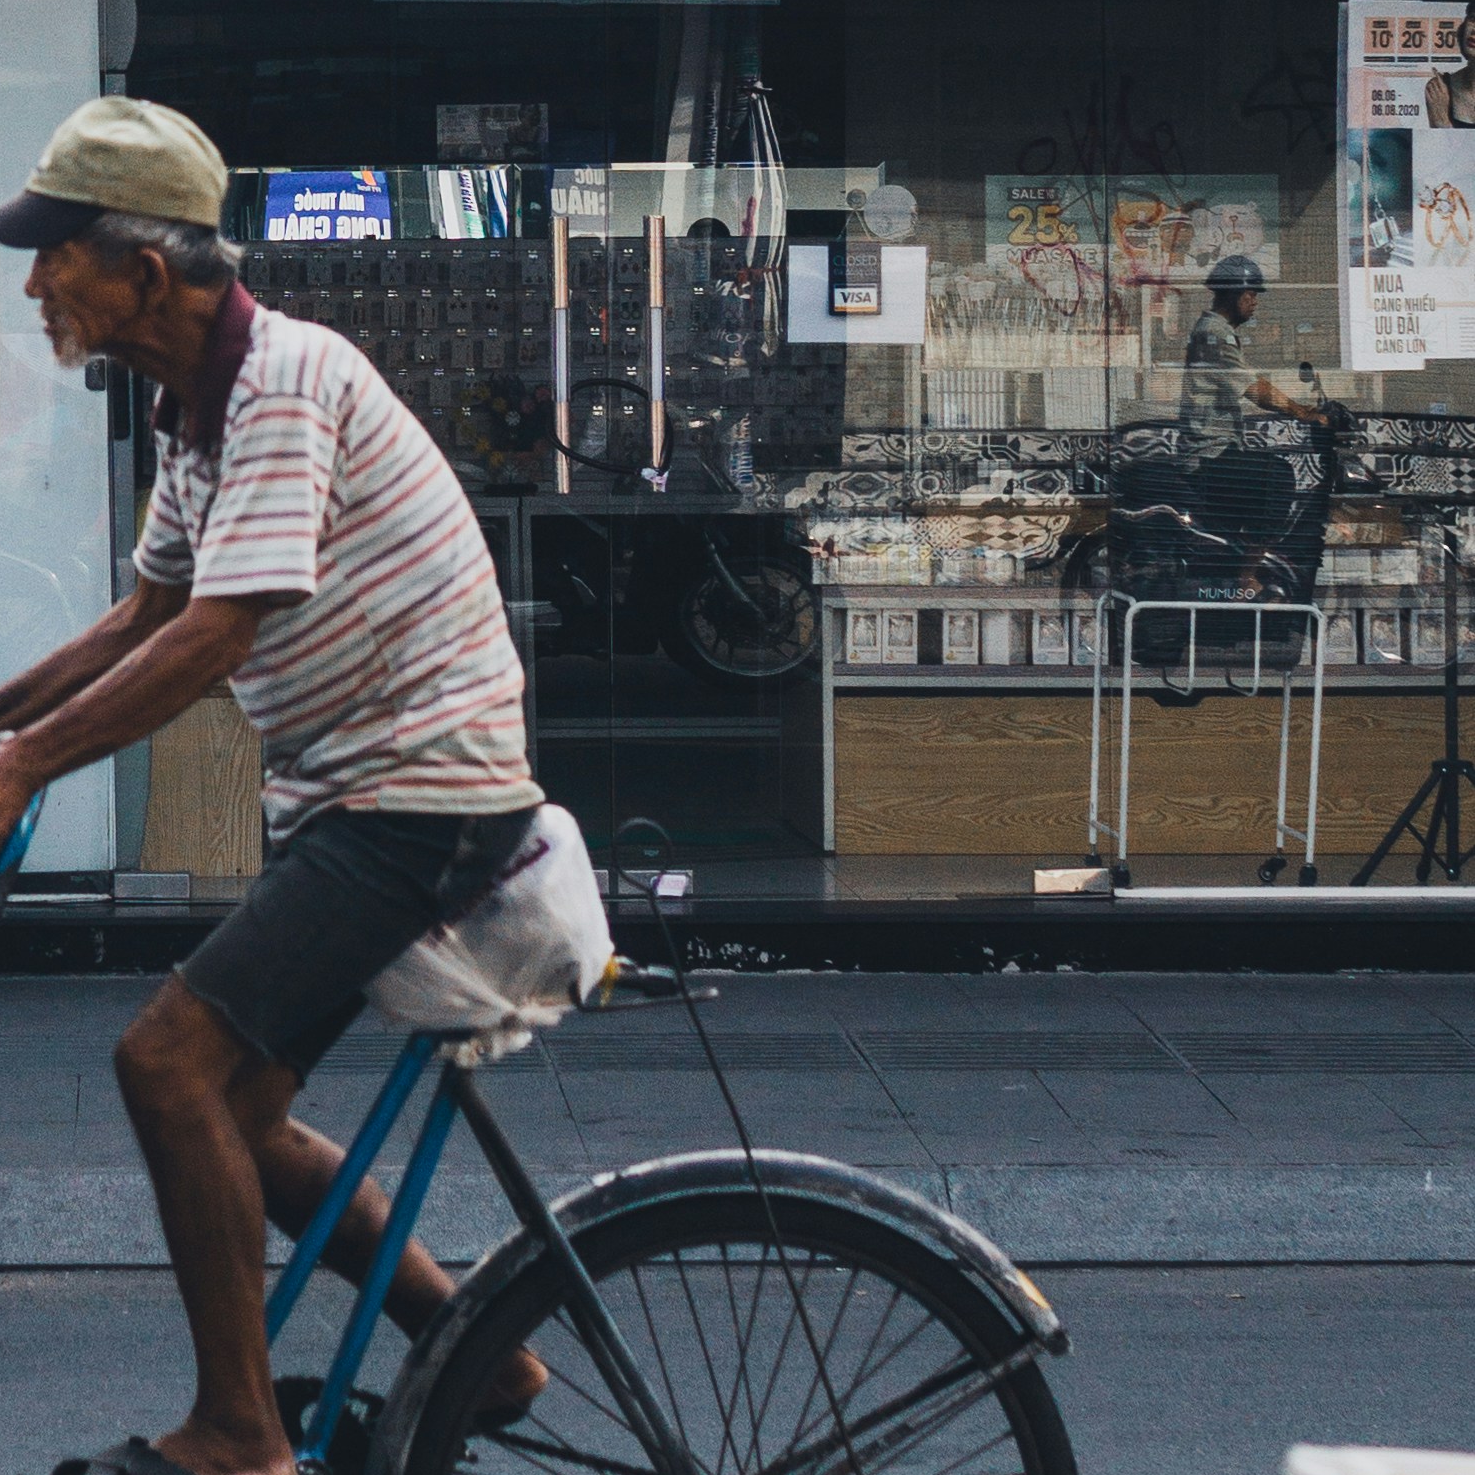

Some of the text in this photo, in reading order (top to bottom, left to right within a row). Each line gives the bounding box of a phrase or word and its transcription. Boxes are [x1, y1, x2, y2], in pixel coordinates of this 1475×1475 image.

[1011, 188, 1045, 200] SALE
[1007, 205, 1079, 245] 25%
[1373, 274, 1404, 293] MUA
[839, 291, 872, 304] VISA
[1198, 587, 1256, 600] MUMUSO
